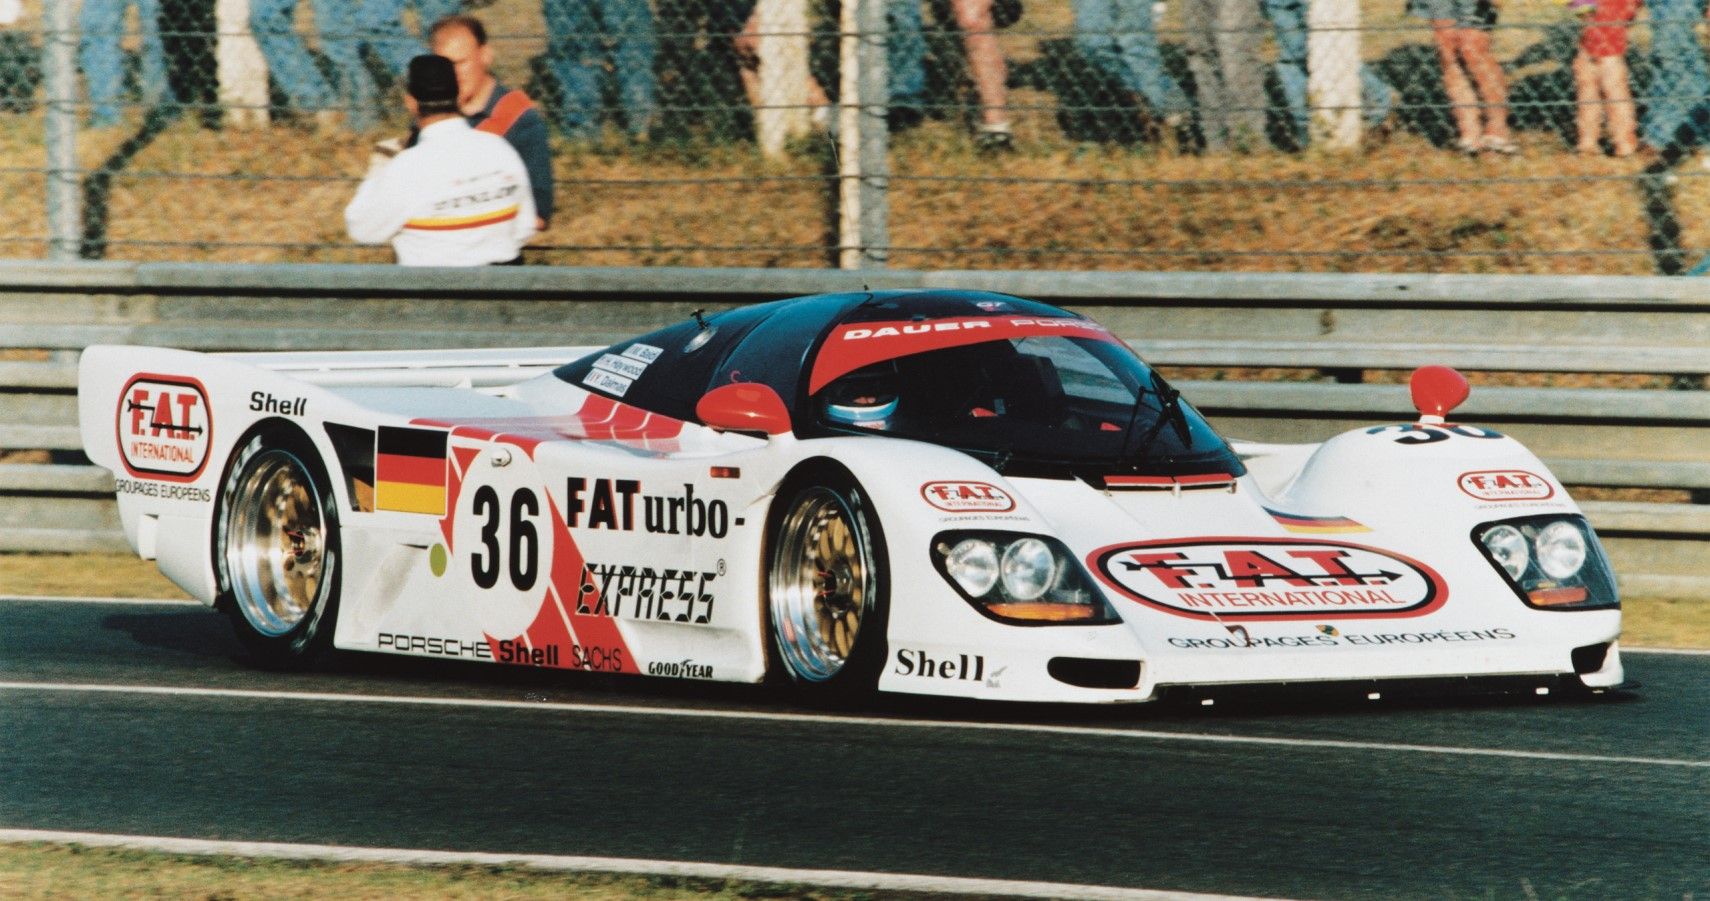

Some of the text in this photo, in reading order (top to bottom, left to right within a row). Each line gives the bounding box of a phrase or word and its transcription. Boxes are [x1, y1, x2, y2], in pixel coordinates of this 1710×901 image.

[843, 320, 992, 341] DAUER
[249, 390, 307, 417] Shell
[131, 442, 194, 464] INTERNATIONAL
[471, 484, 540, 592] 36
[1177, 588, 1407, 608] INTERNATIONAL
[378, 632, 623, 672] PORSCHE Shell SACHS
[1167, 633, 1339, 649] GROUPAGES
[895, 648, 984, 682] Shell
